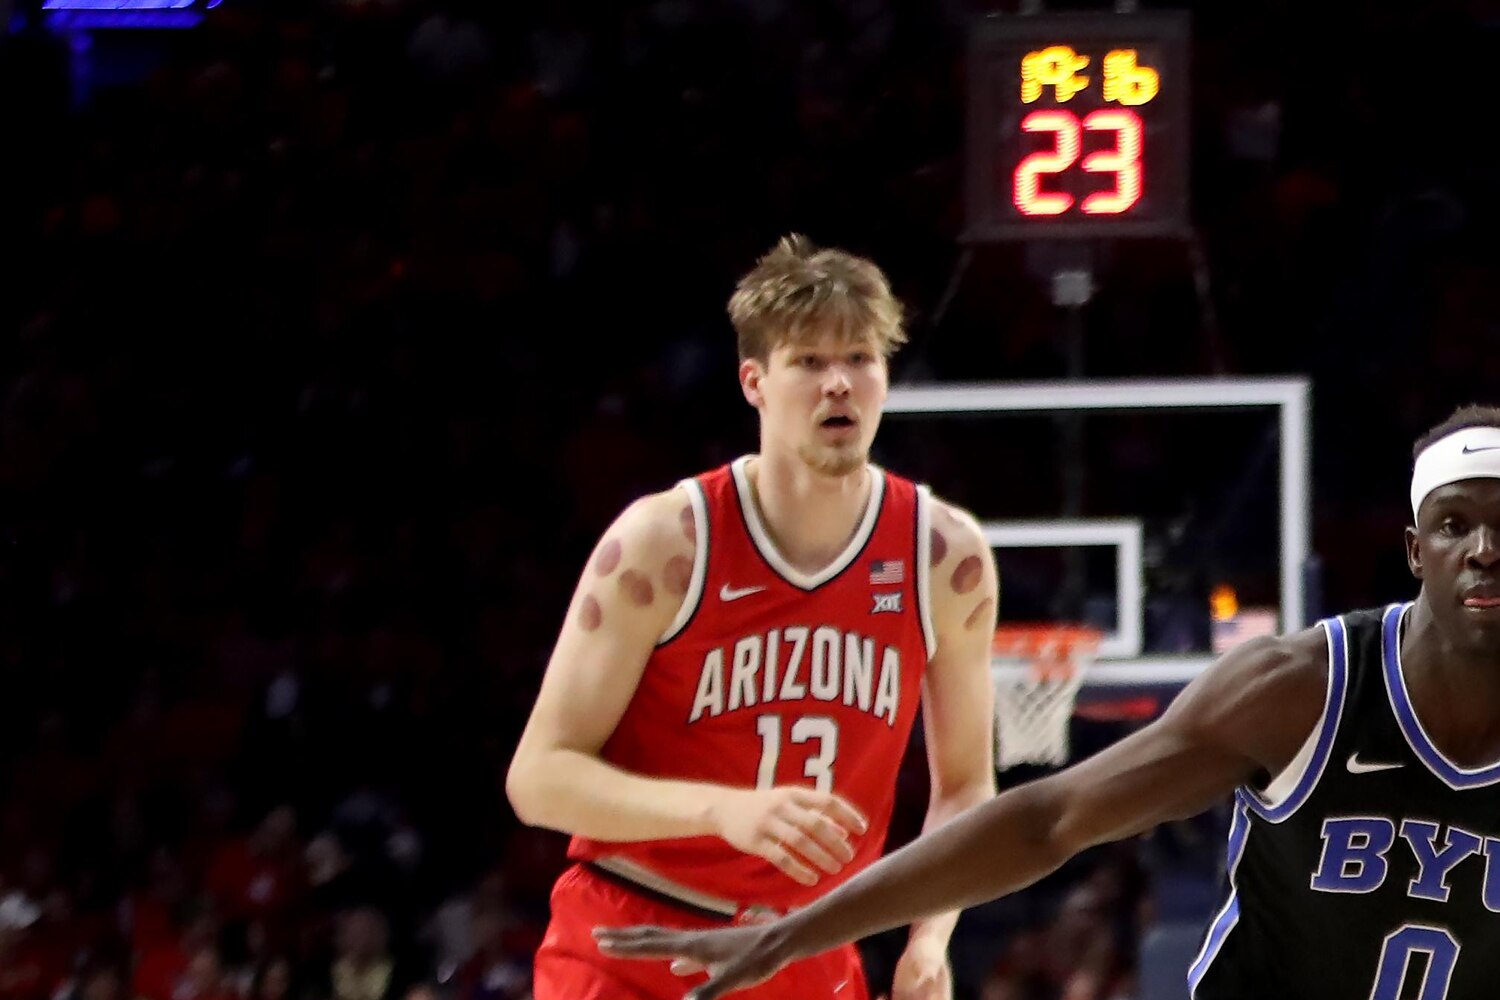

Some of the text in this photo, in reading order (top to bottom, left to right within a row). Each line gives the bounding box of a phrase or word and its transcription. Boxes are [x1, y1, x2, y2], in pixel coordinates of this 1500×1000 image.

[1013, 108, 1143, 216] 23
[688, 624, 901, 729] ARIZONA
[755, 714, 839, 794] 13
